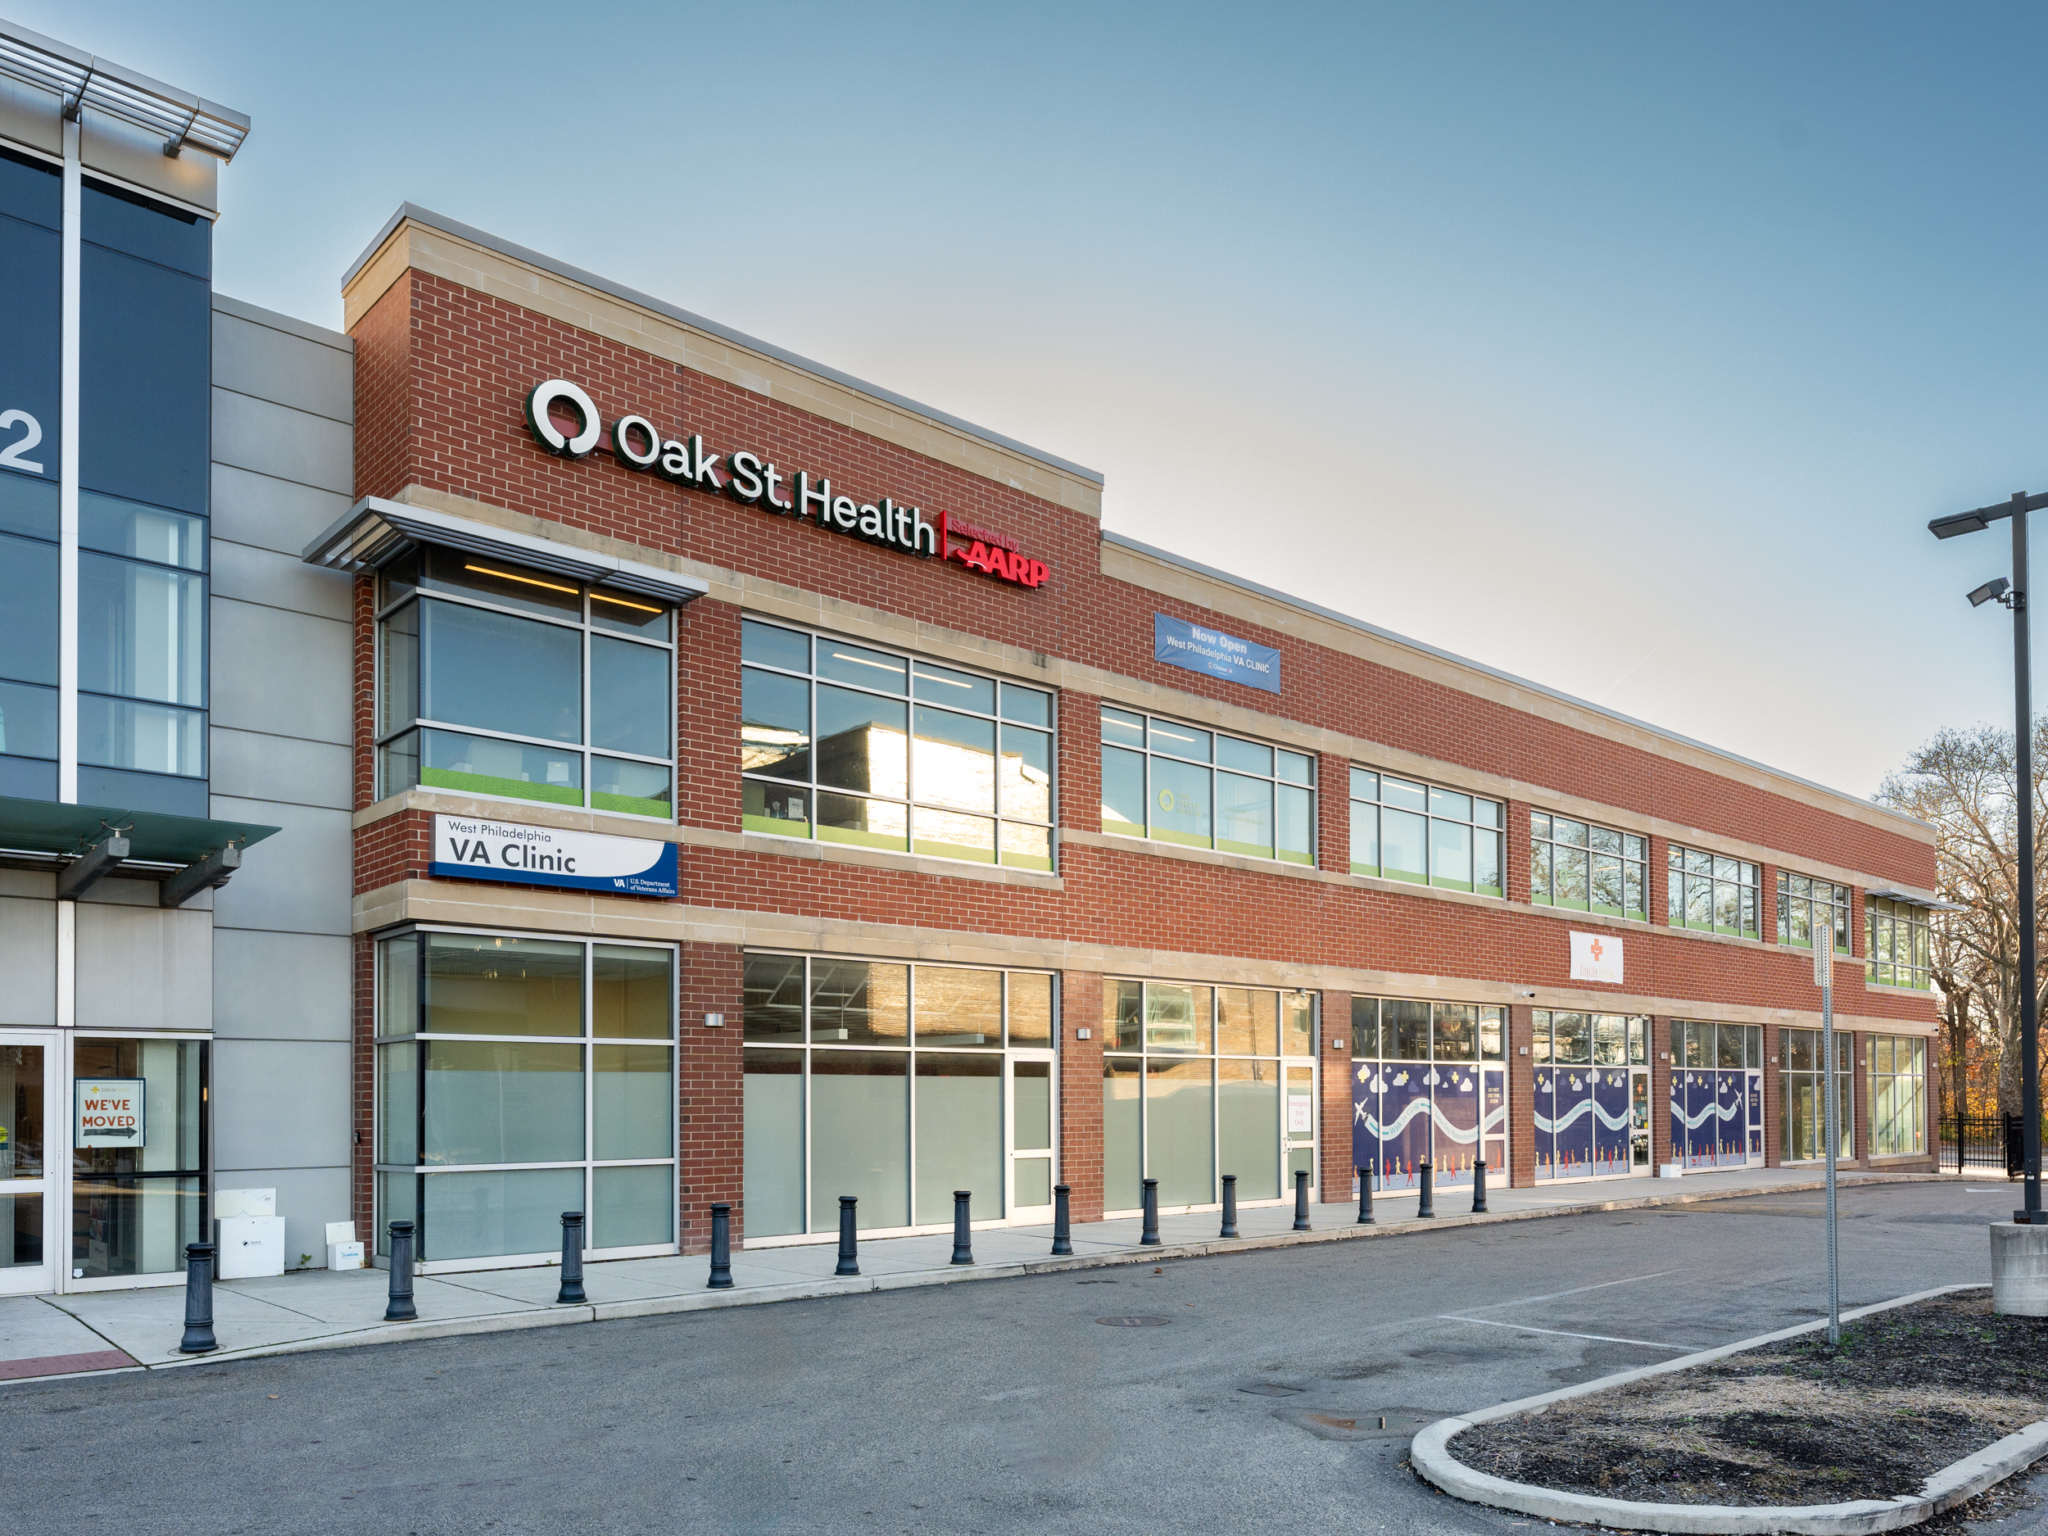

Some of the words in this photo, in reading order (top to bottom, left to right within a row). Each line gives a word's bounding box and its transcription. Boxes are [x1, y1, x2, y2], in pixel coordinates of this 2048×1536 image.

[0, 409, 44, 474] 2
[612, 414, 722, 491] Oak
[729, 450, 791, 510] St.
[797, 470, 935, 556] Health
[951, 519, 1003, 546] Selected
[1004, 535, 1018, 553] by
[954, 540, 1050, 588] AARP
[1192, 627, 1216, 645] Now
[1219, 635, 1247, 654] Open
[1166, 635, 1186, 650] West
[1187, 641, 1232, 663] Philadelphia
[1233, 654, 1244, 667] VA
[1245, 659, 1270, 674] CLINIC
[448, 820, 477, 834] West
[481, 824, 551, 843] Philadelphia
[449, 837, 491, 865] VA
[501, 843, 576, 873] Clinic
[613, 878, 625, 888] VA
[640, 879, 670, 888] Department
[636, 885, 657, 893] Veterans
[658, 887, 675, 895] Affairs
[84, 1099, 130, 1111] WE'VE
[82, 1116, 136, 1127] MOVED
[1294, 1119, 1305, 1127] Only
